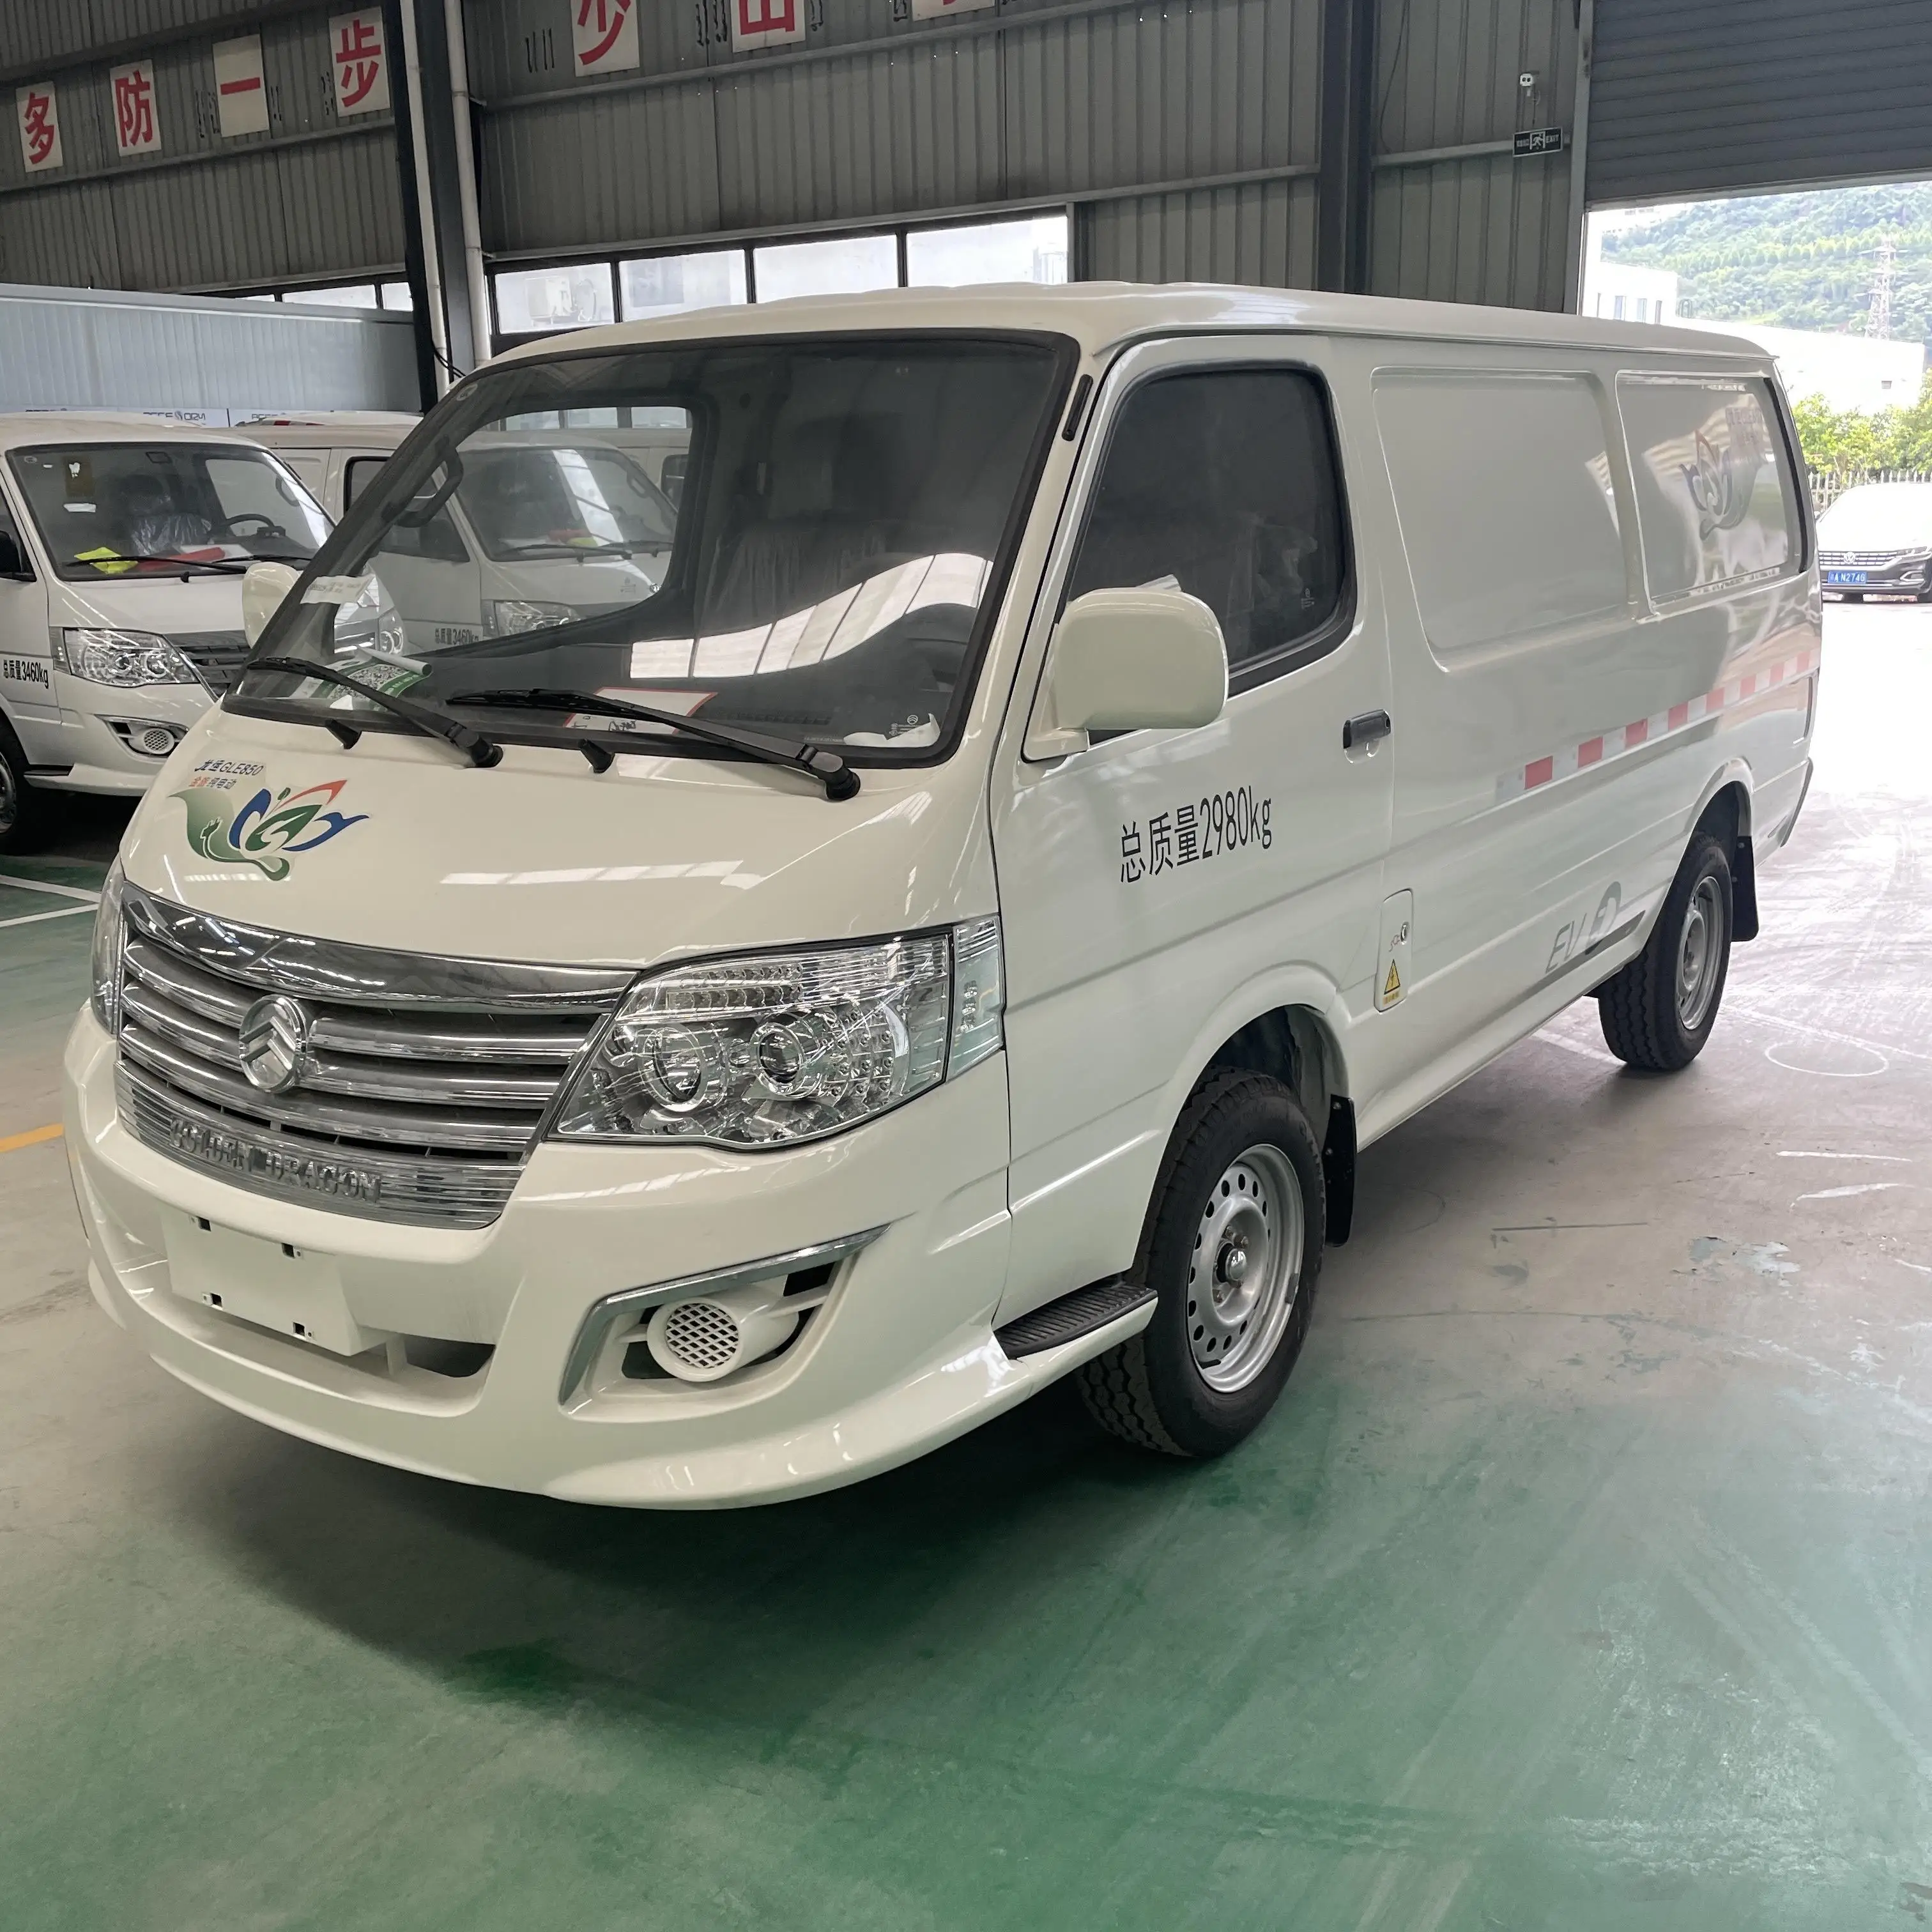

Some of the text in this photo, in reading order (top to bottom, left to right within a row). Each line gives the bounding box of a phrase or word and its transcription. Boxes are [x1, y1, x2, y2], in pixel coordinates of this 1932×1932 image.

[1546, 134, 1559, 143] EXIT
[3, 659, 49, 689] 总质量3460kg
[1120, 786, 1272, 883] 总质量2980kg
[266, 1150, 381, 1202] DRAGON
